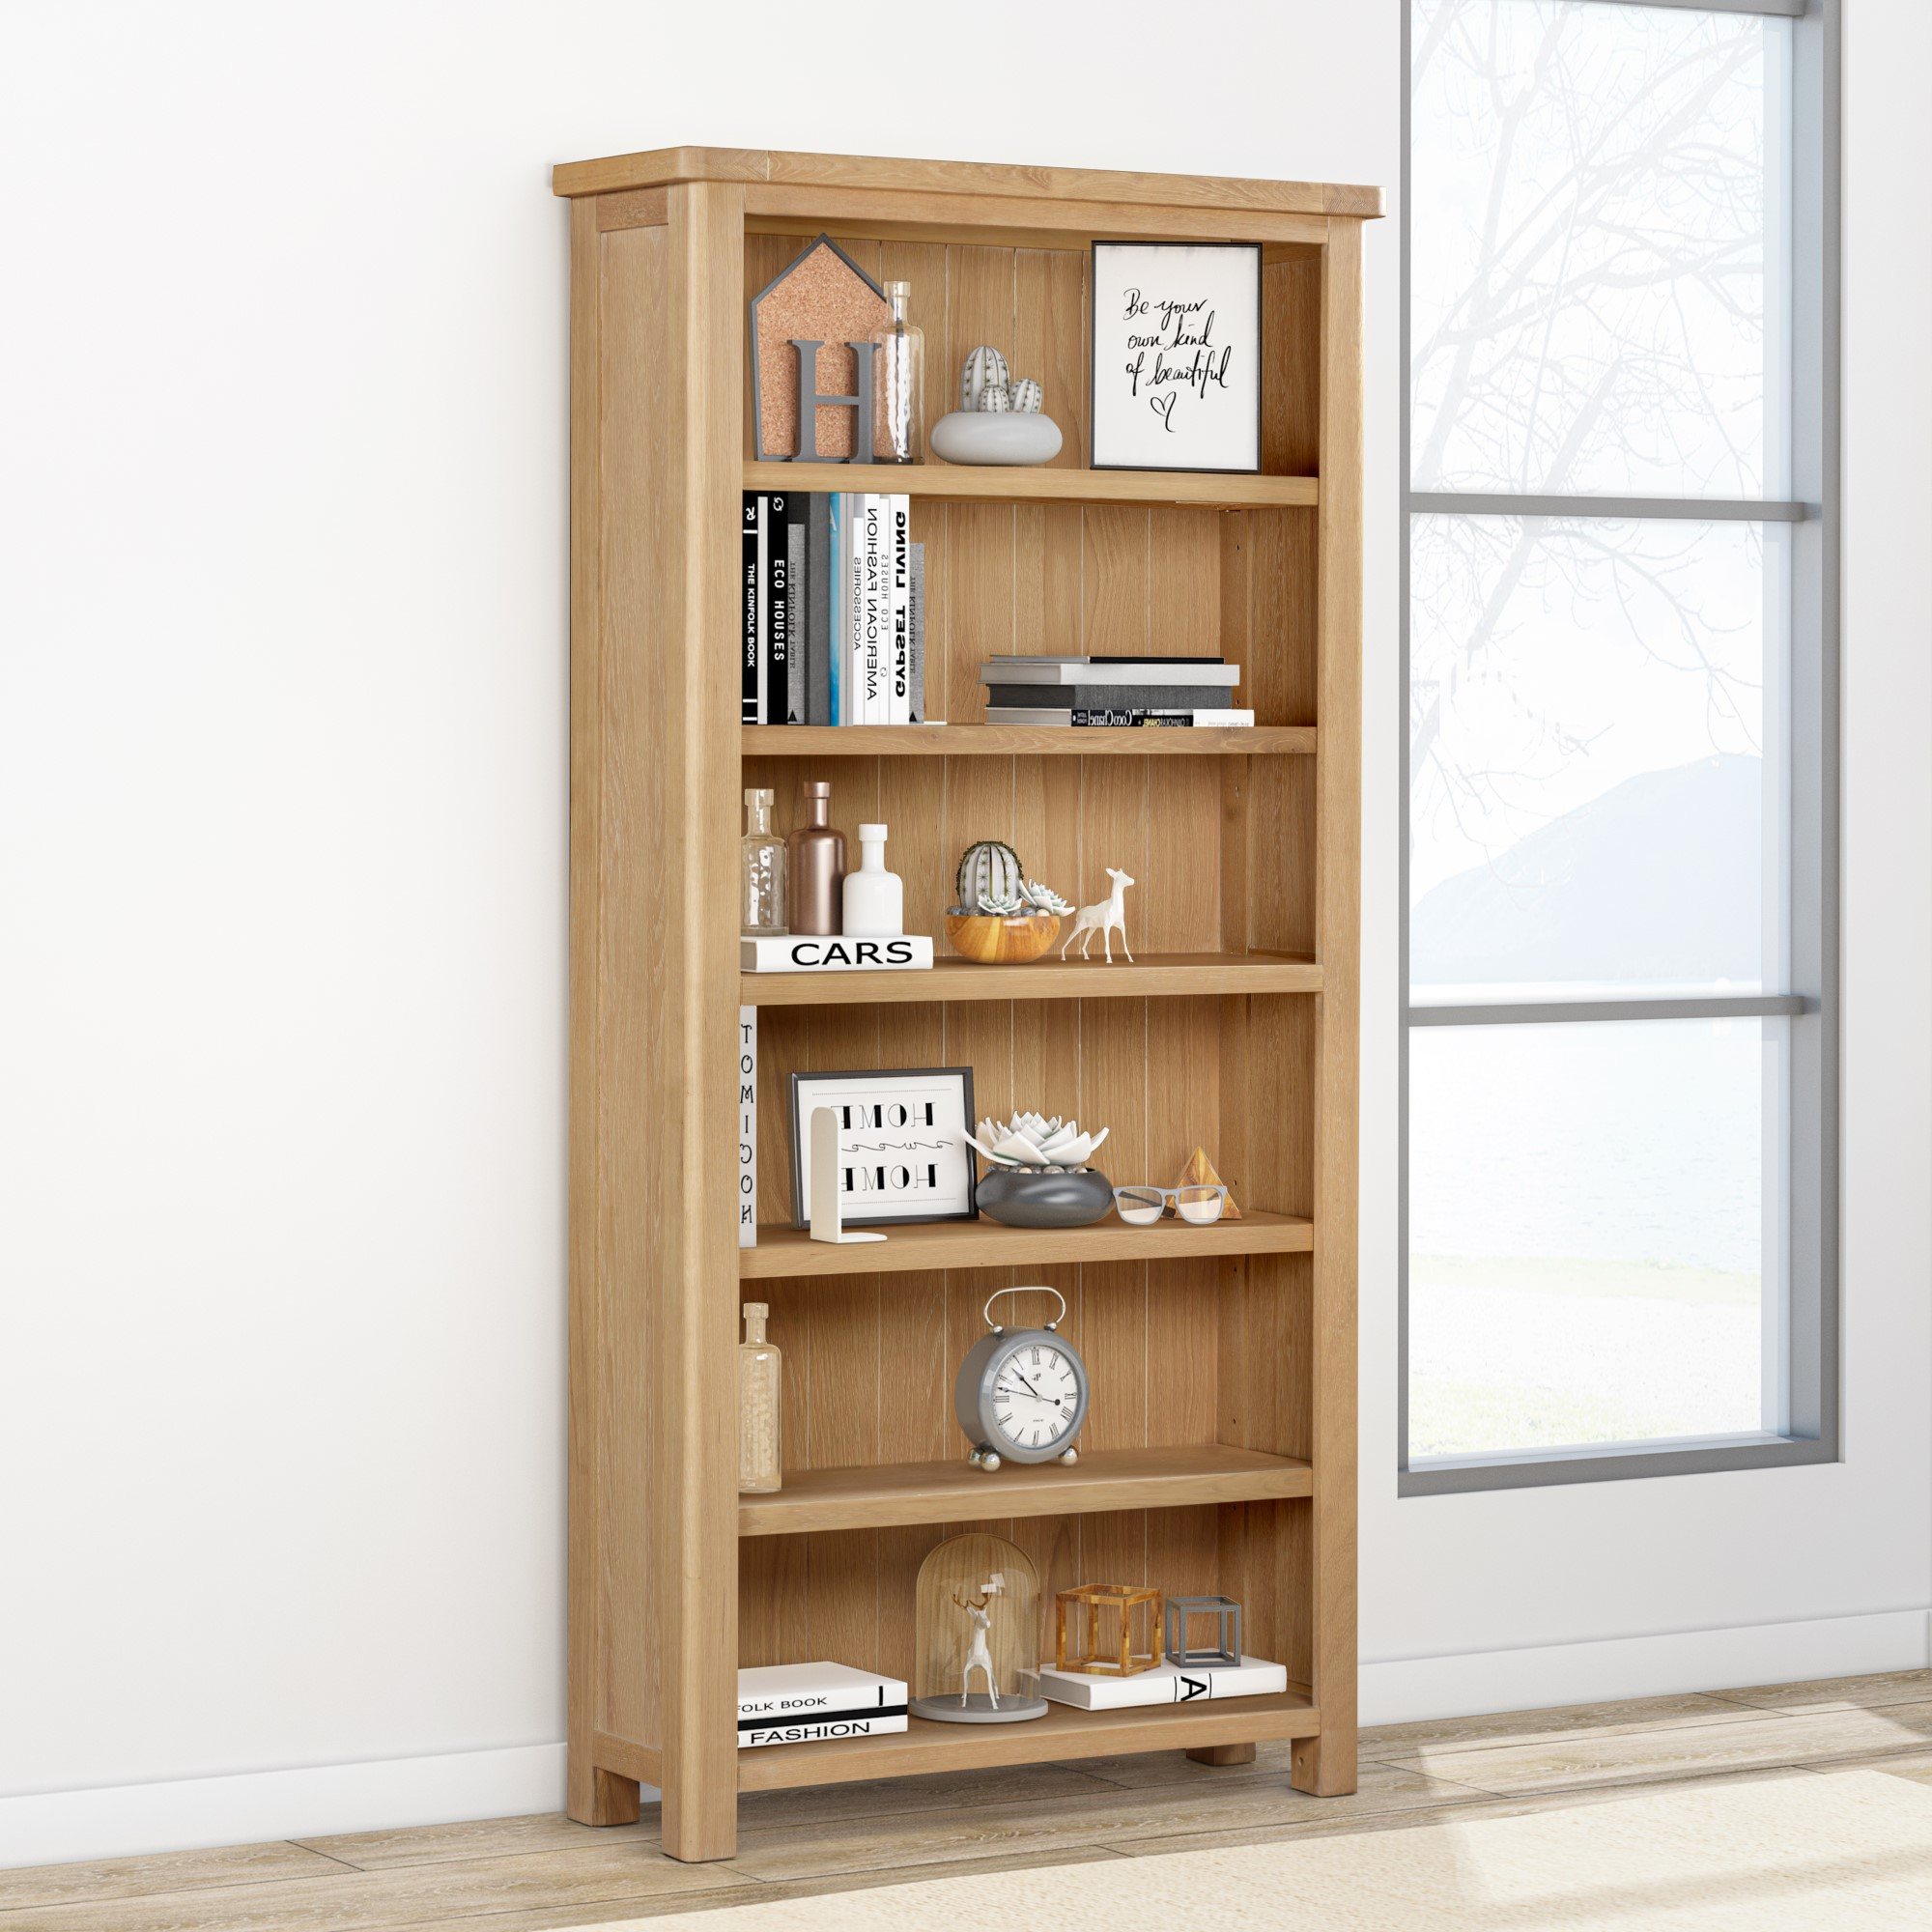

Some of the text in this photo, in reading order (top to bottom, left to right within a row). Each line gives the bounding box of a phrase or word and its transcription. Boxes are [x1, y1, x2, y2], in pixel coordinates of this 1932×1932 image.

[1123, 288, 1208, 330] Be your
[1127, 310, 1215, 351] own kind
[1125, 346, 1232, 399] of beautiful
[786, 339, 882, 464] H
[775, 560, 784, 661] ECO HOUSES
[791, 942, 913, 965] CARS
[781, 1697, 828, 1710] BOOK
[1180, 1676, 1208, 1701] A
[751, 1721, 870, 1745] FASHION
